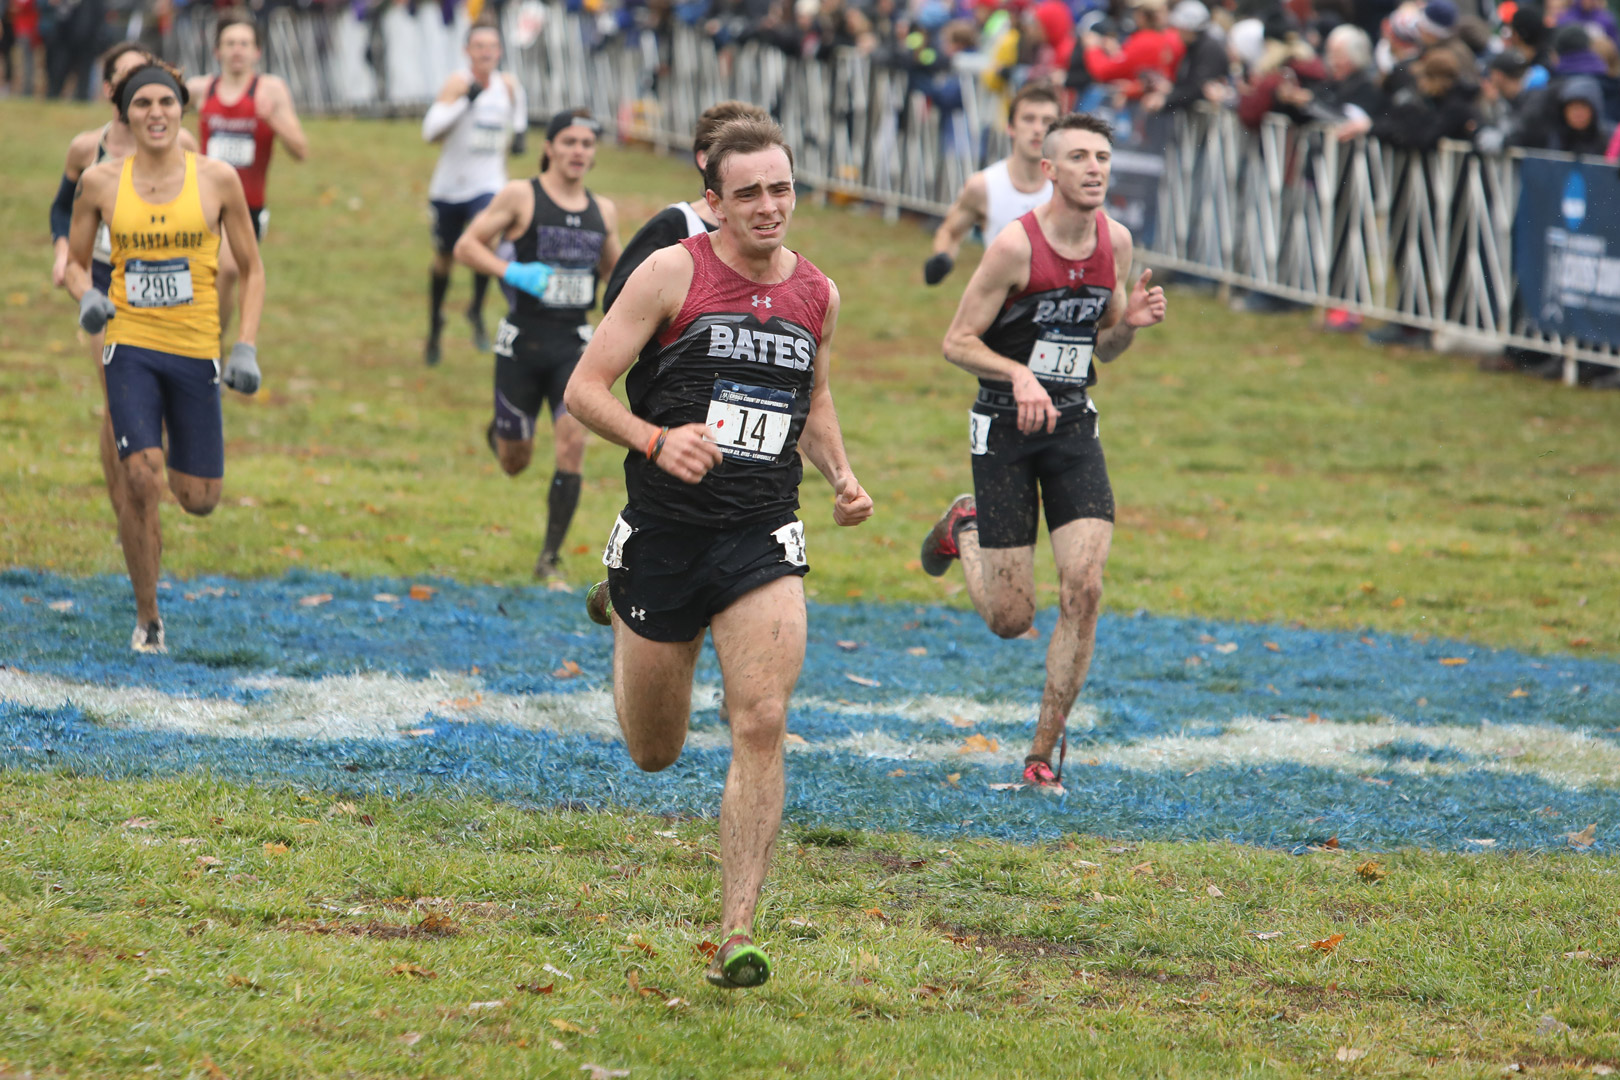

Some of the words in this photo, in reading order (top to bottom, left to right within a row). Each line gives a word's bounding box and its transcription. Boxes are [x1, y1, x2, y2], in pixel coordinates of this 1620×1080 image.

[132, 232, 169, 249] SANTA
[175, 231, 203, 248] CRUZ
[140, 274, 177, 299] 296
[1032, 297, 1107, 323] BATES
[707, 324, 811, 372] BATES
[1051, 346, 1078, 375] 13
[733, 409, 768, 452] 14
